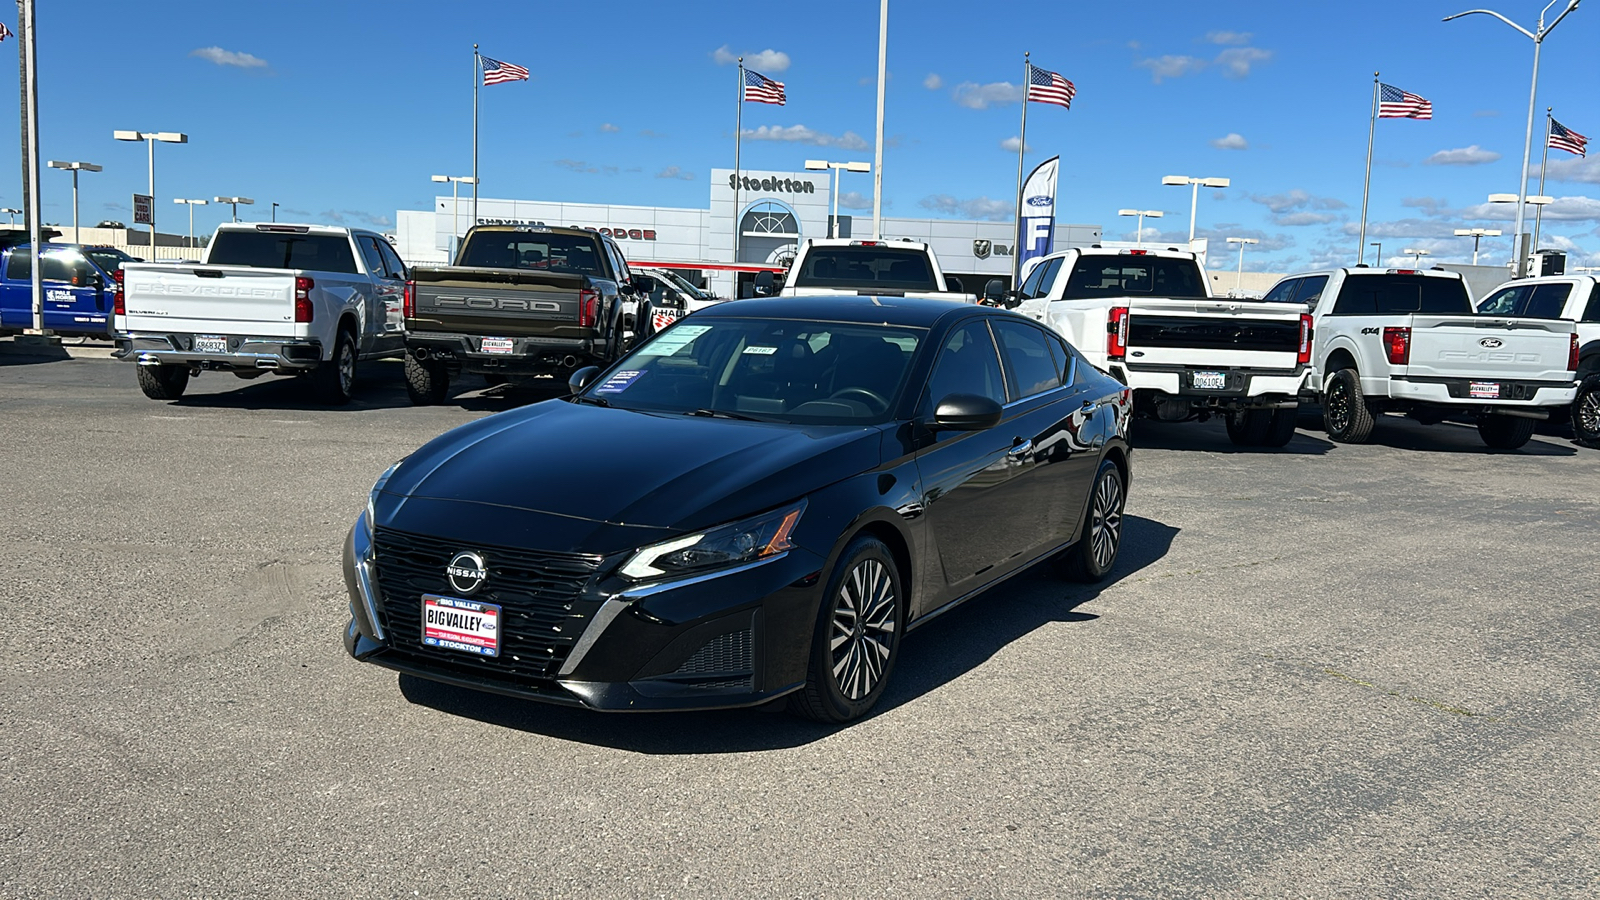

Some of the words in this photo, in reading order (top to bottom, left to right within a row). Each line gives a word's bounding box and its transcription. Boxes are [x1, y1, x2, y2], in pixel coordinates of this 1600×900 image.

[729, 173, 814, 194] Stockton
[135, 212, 150, 222] CARS
[135, 283, 283, 298] CHEVROLET
[434, 296, 560, 312] FORD
[1483, 338, 1500, 348] Ford
[1438, 350, 1542, 364] F-150
[447, 566, 486, 580] NISSAN
[440, 598, 454, 606] BIG
[454, 600, 481, 610] VALLEY
[428, 609, 482, 631] BIGVALLEY
[439, 640, 482, 652] STOCKTON
